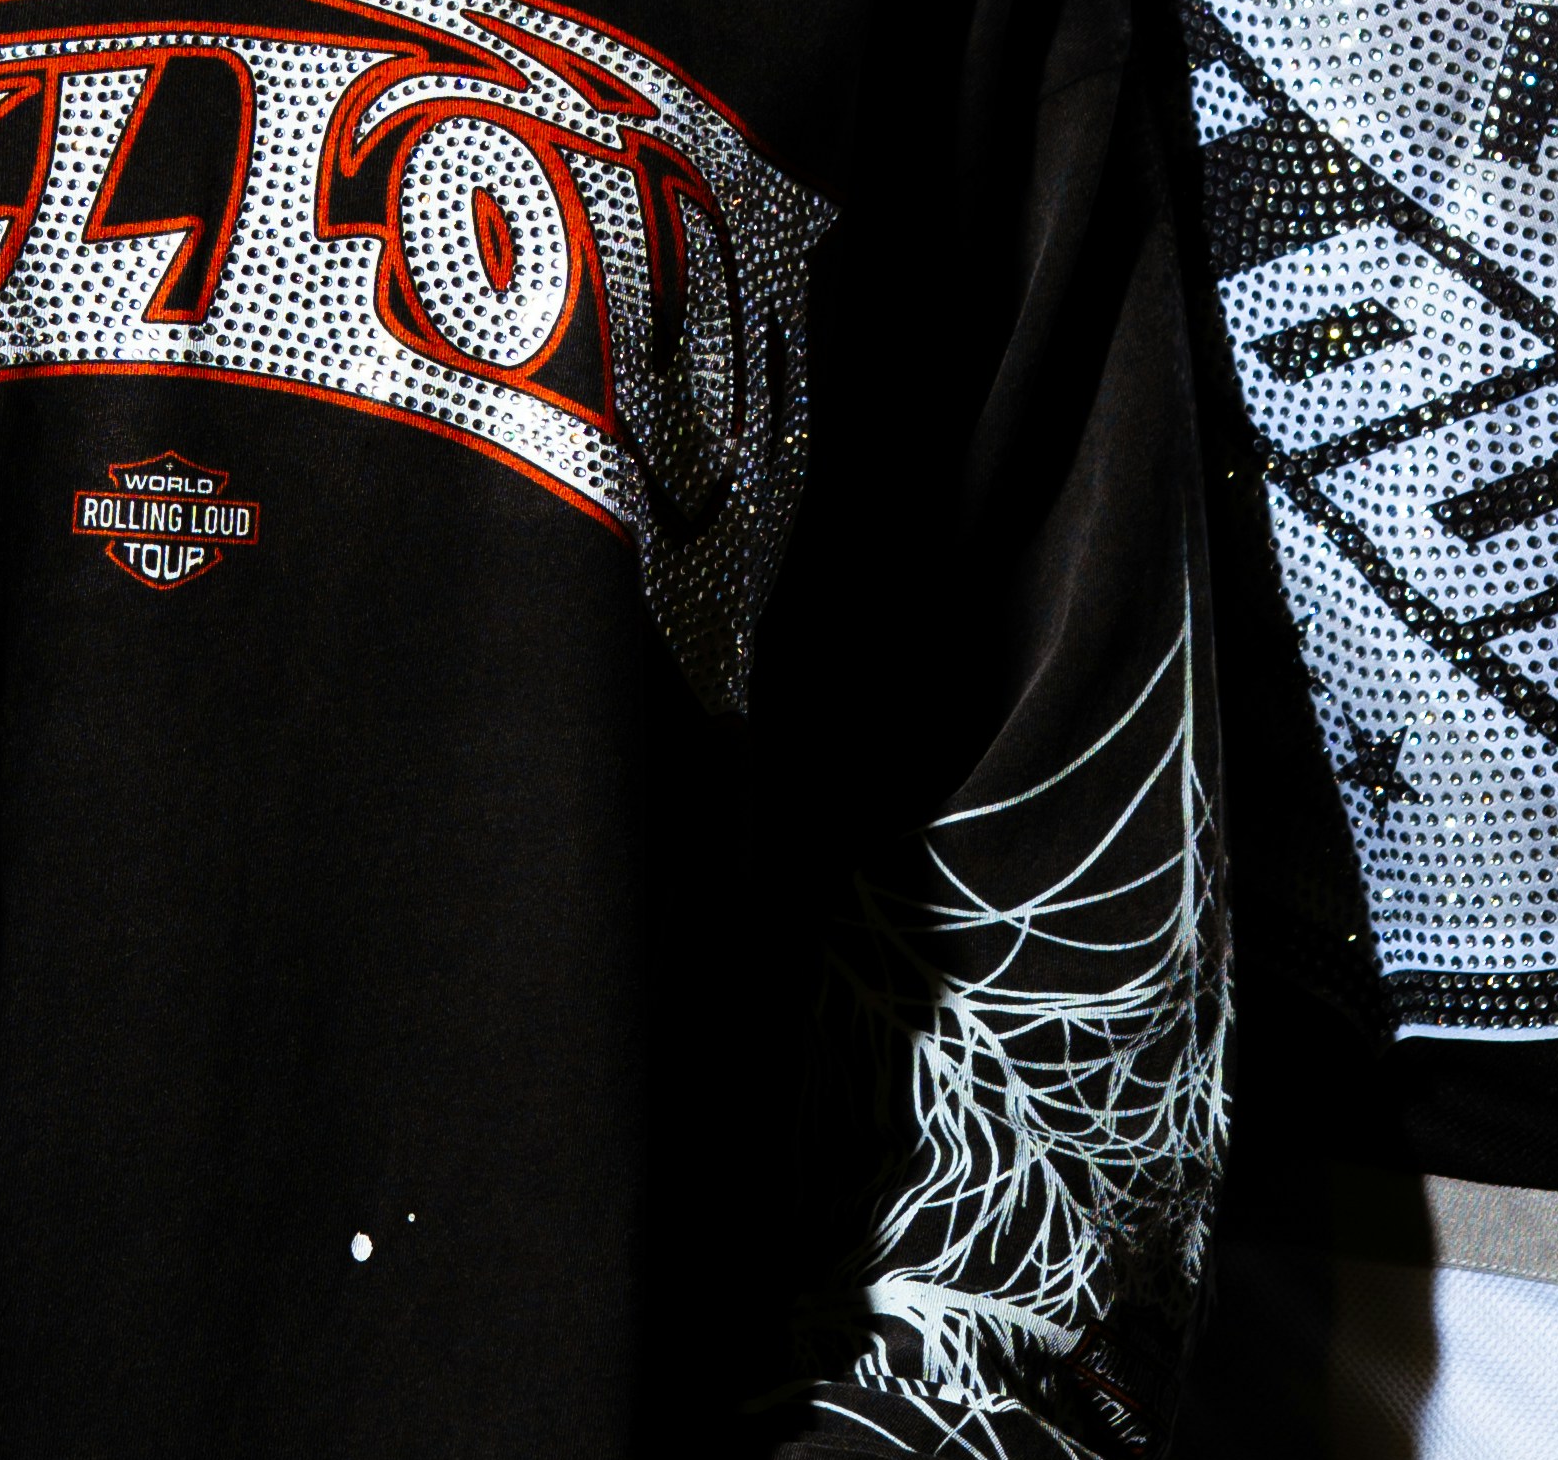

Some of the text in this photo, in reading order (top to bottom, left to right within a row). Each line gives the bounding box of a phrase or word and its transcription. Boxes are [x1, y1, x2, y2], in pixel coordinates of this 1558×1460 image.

[123, 472, 214, 495] WORLD
[82, 497, 251, 537] ROLLING LOUD
[123, 541, 206, 581] TOUR
